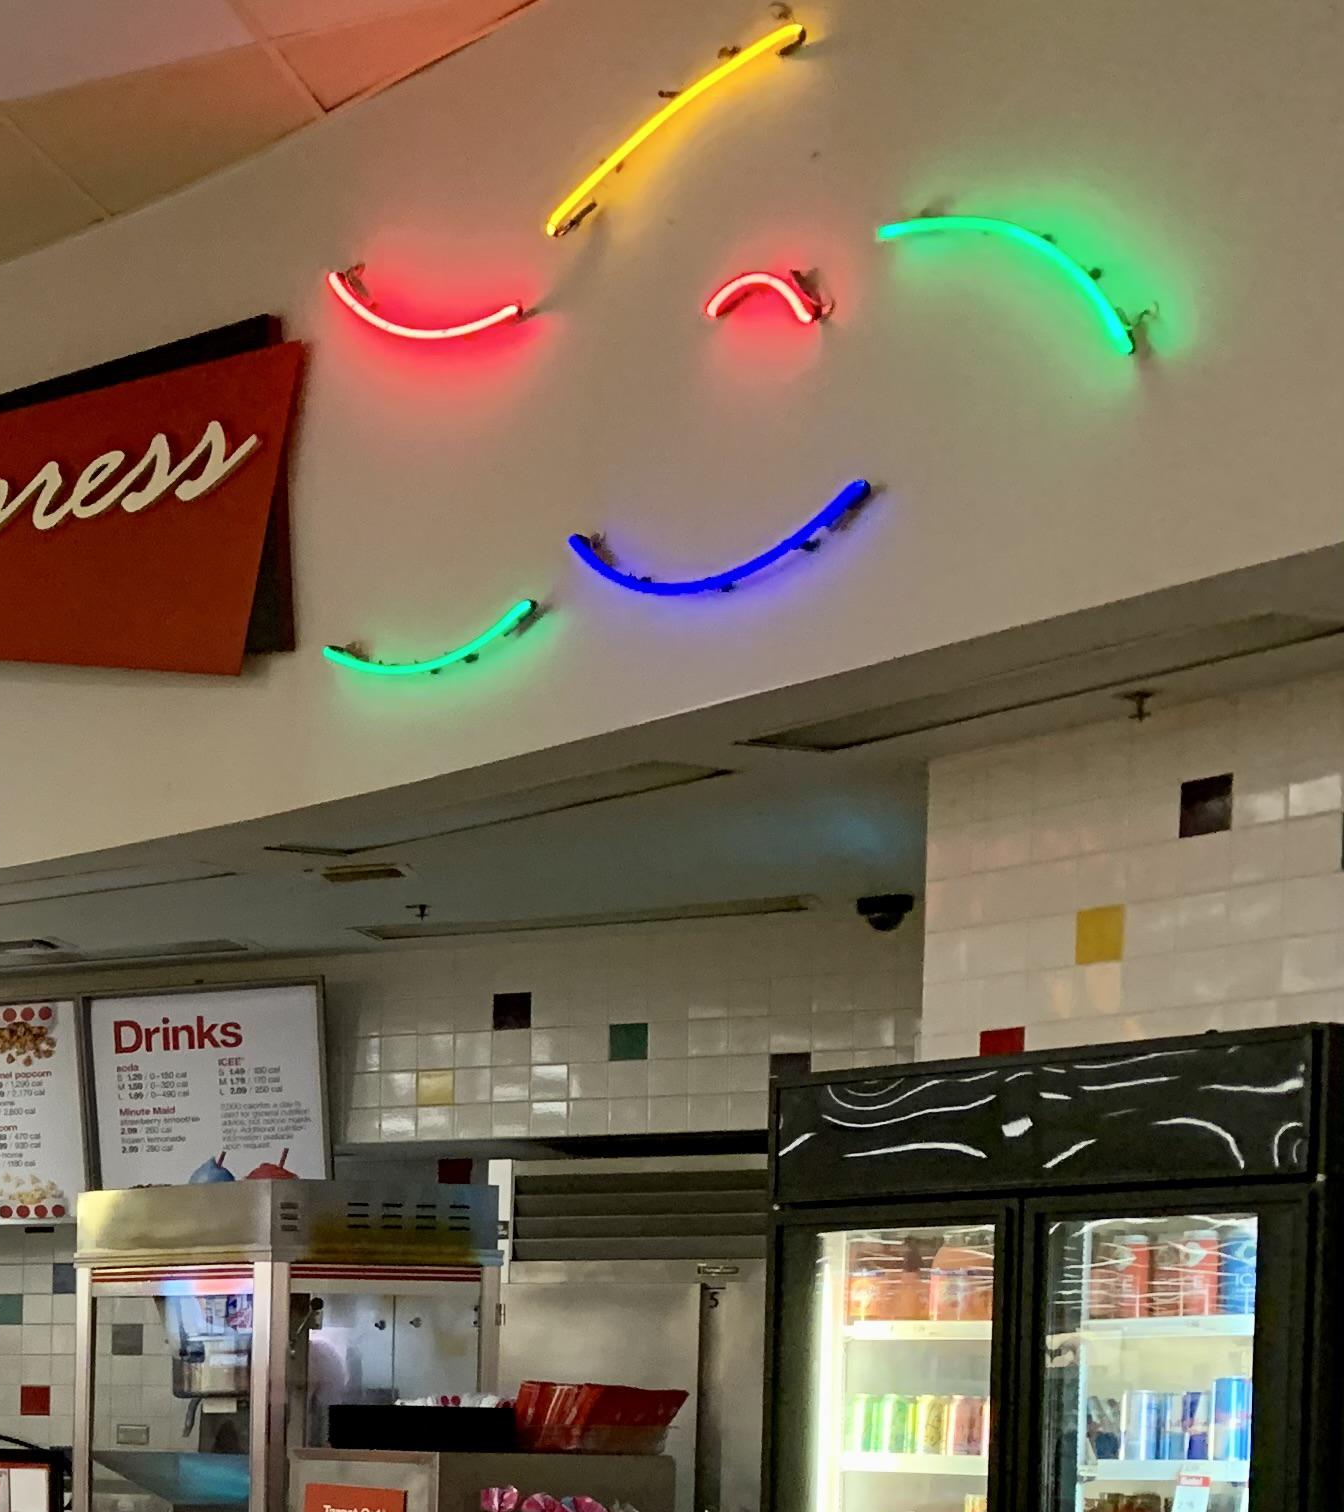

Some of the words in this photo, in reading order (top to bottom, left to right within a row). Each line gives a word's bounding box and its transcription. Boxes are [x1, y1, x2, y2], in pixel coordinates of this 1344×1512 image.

[114, 1016, 243, 1054] Drinks
[117, 1063, 139, 1072] soda
[15, 1071, 52, 1080] popcorn
[119, 1108, 151, 1116] Minute
[153, 1106, 176, 1115] Maid
[1235, 1273, 1254, 1287] IC
